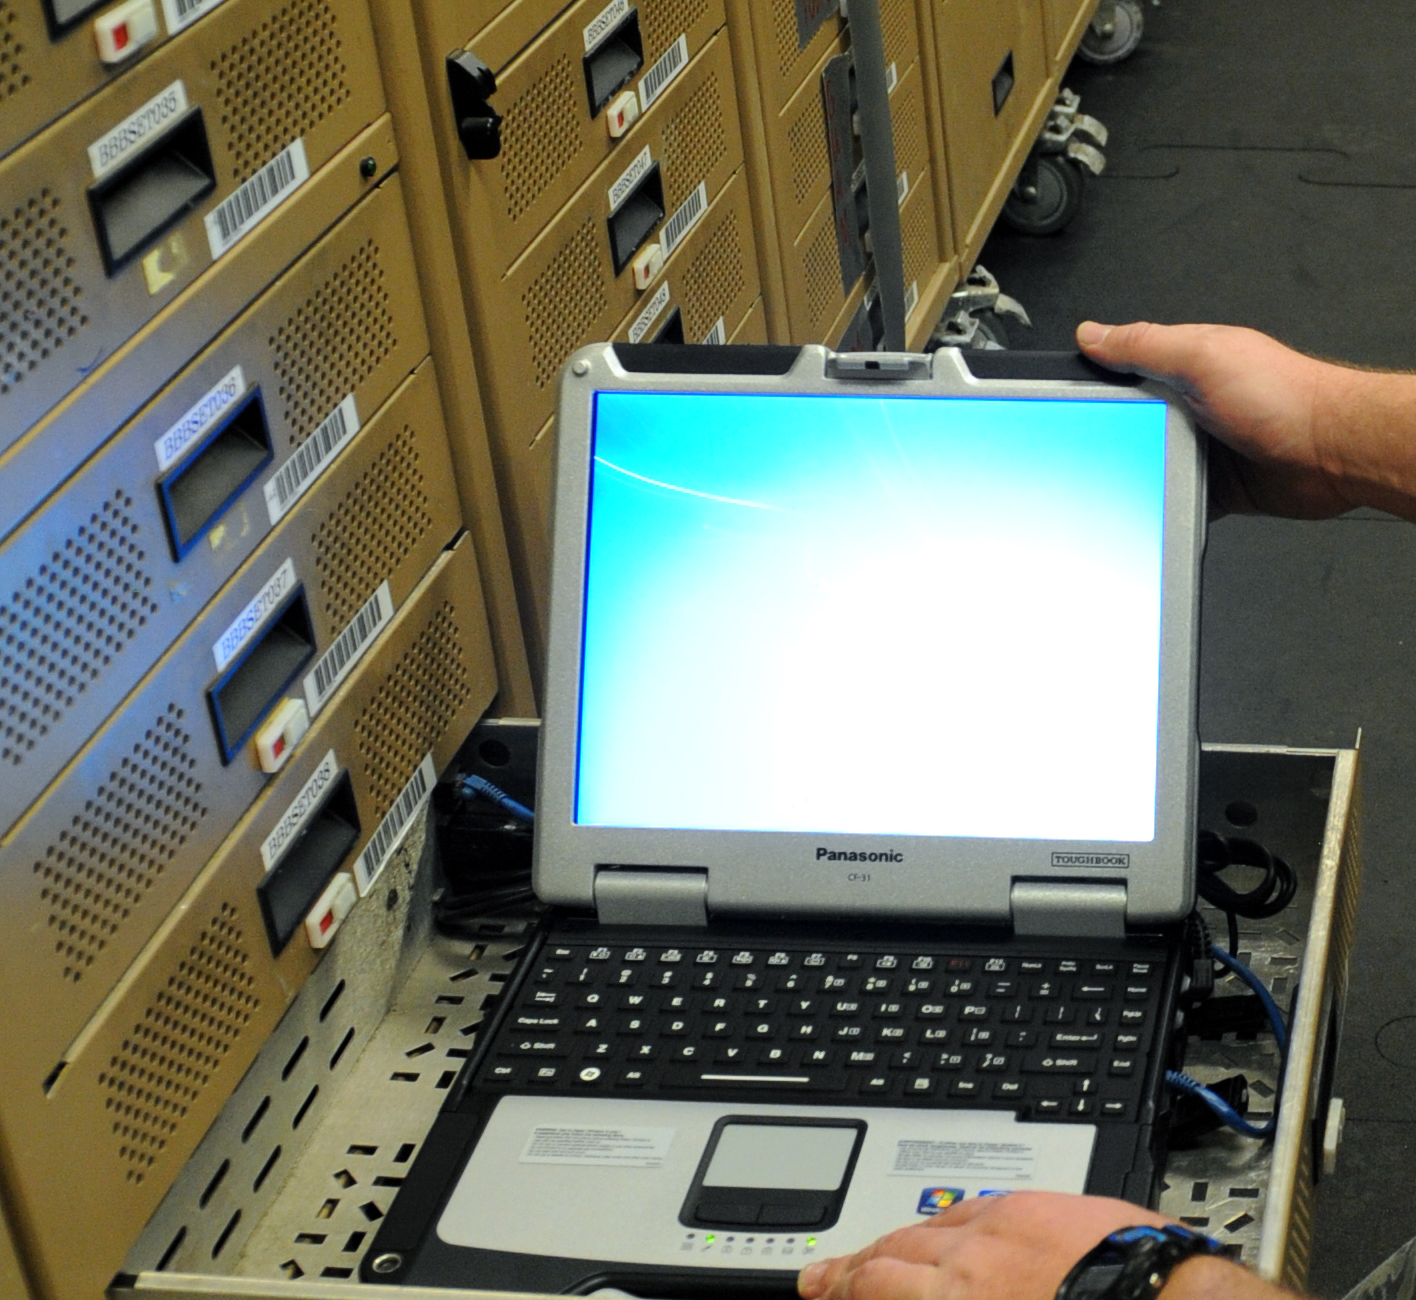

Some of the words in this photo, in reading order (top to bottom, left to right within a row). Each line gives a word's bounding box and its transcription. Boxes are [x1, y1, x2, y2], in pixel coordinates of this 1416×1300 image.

[99, 90, 178, 168] BBBSET035
[164, 376, 236, 461] BBBSET036
[221, 568, 288, 662] BBBSET037
[266, 760, 331, 861] BBBSET038
[816, 847, 904, 863] Panasonic
[847, 873, 871, 882] CF-31
[1055, 855, 1127, 866] TOUGHBOOK
